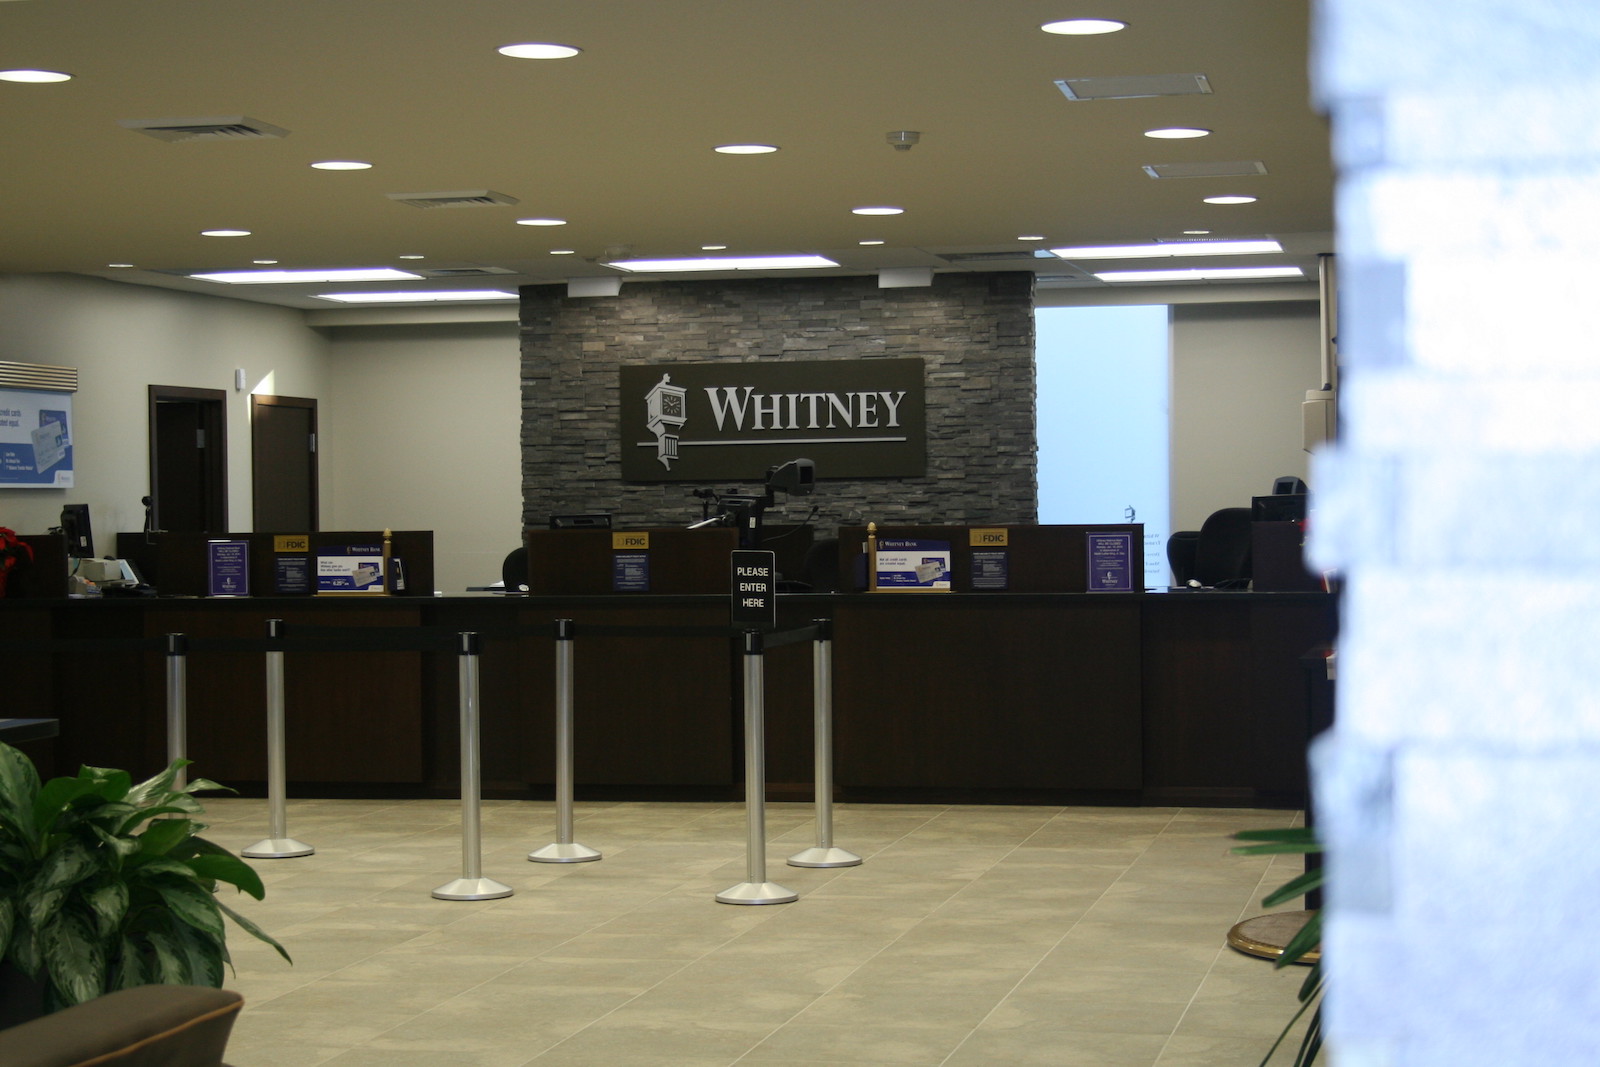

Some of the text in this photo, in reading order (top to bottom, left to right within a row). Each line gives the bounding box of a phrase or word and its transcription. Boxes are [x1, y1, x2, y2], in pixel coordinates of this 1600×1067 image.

[704, 386, 906, 432] WHITNEY
[983, 534, 1004, 542] FDIC
[737, 567, 769, 576] PLEASE
[740, 583, 766, 592] ENTER
[742, 598, 764, 607] HERE
